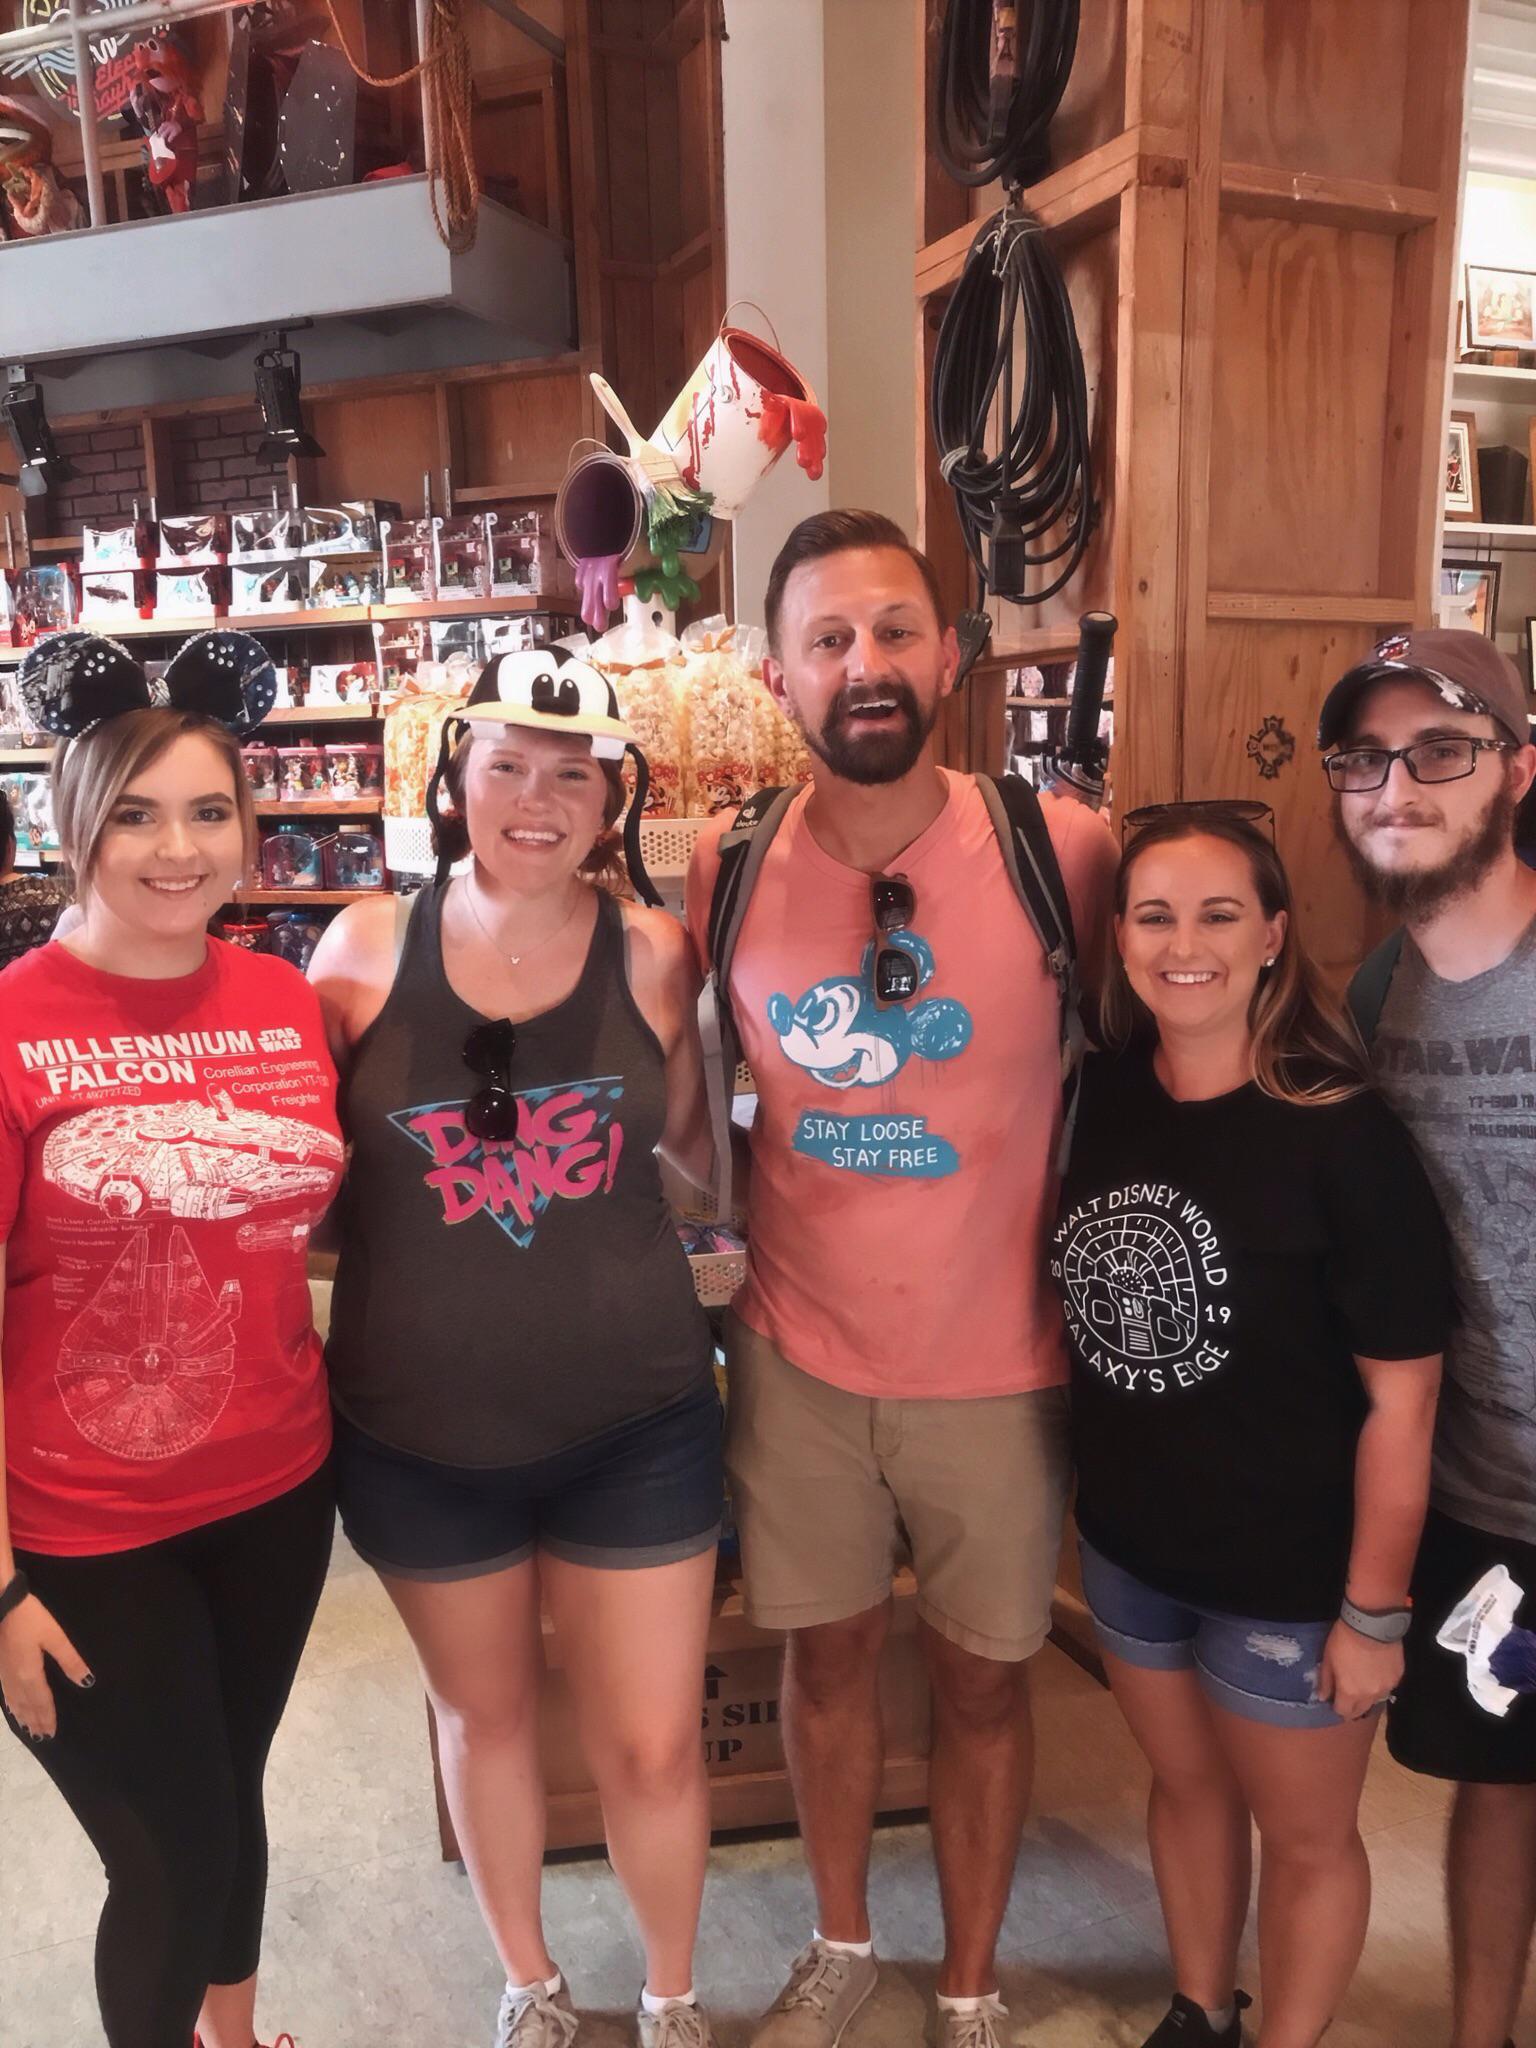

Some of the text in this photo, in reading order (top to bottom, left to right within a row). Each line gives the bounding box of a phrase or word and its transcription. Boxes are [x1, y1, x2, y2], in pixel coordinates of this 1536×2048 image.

[258, 1027, 301, 1041] STAR
[260, 1038, 302, 1053] WARS
[18, 1030, 255, 1069] MILLENNIUM
[1372, 1035, 1536, 1076] TAR WA
[45, 1060, 196, 1095] FALCON
[203, 1065, 260, 1079] Corellian
[231, 1079, 301, 1094] Corporation
[407, 1092, 597, 1168] DG
[803, 1118, 923, 1141] STAY LOOSE
[833, 1147, 938, 1168] STAY FREE
[424, 1122, 624, 1225] DANG!
[1053, 1183, 1228, 1286] WALT DISNEY WORLD
[1050, 1259, 1062, 1278] 20
[1204, 1304, 1232, 1325] 19
[1063, 1300, 1230, 1393] GALAXY'S EDGE
